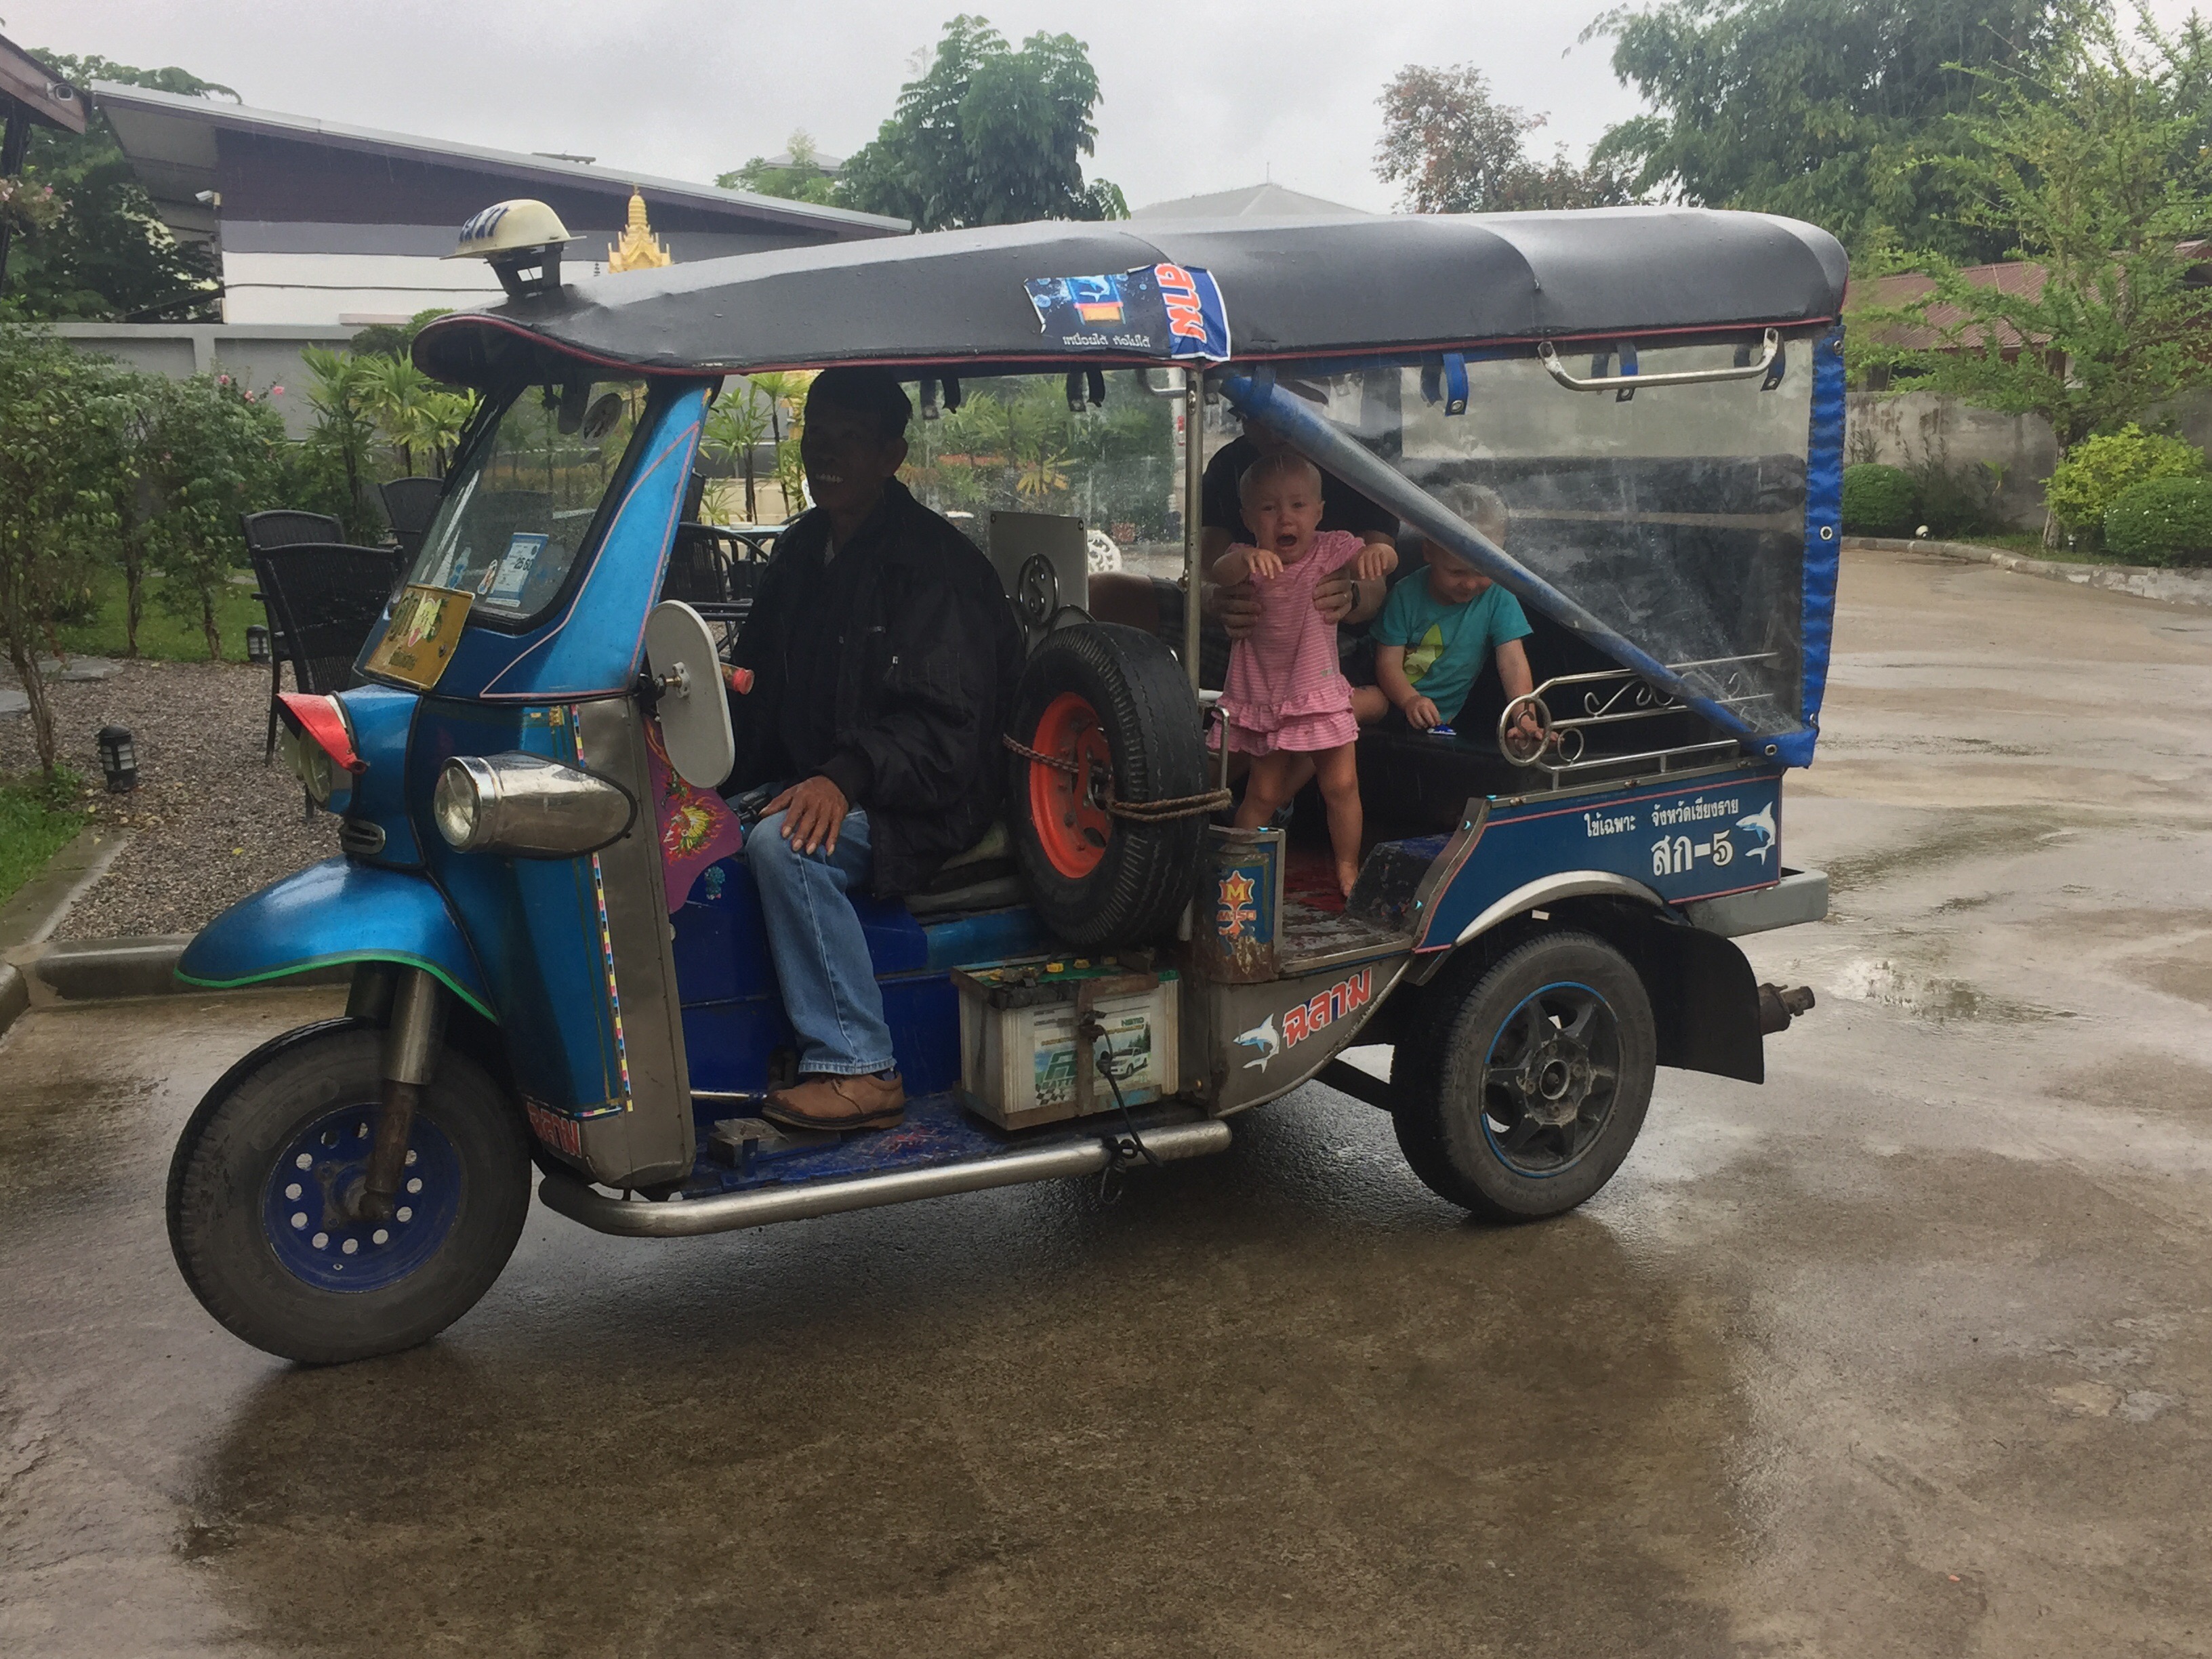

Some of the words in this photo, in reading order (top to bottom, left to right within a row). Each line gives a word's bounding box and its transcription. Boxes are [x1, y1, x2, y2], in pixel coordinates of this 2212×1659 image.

[1650, 830, 1734, 876] สก-5
[1226, 883, 1246, 901] M
[1282, 966, 1372, 1048] ฉลาม
